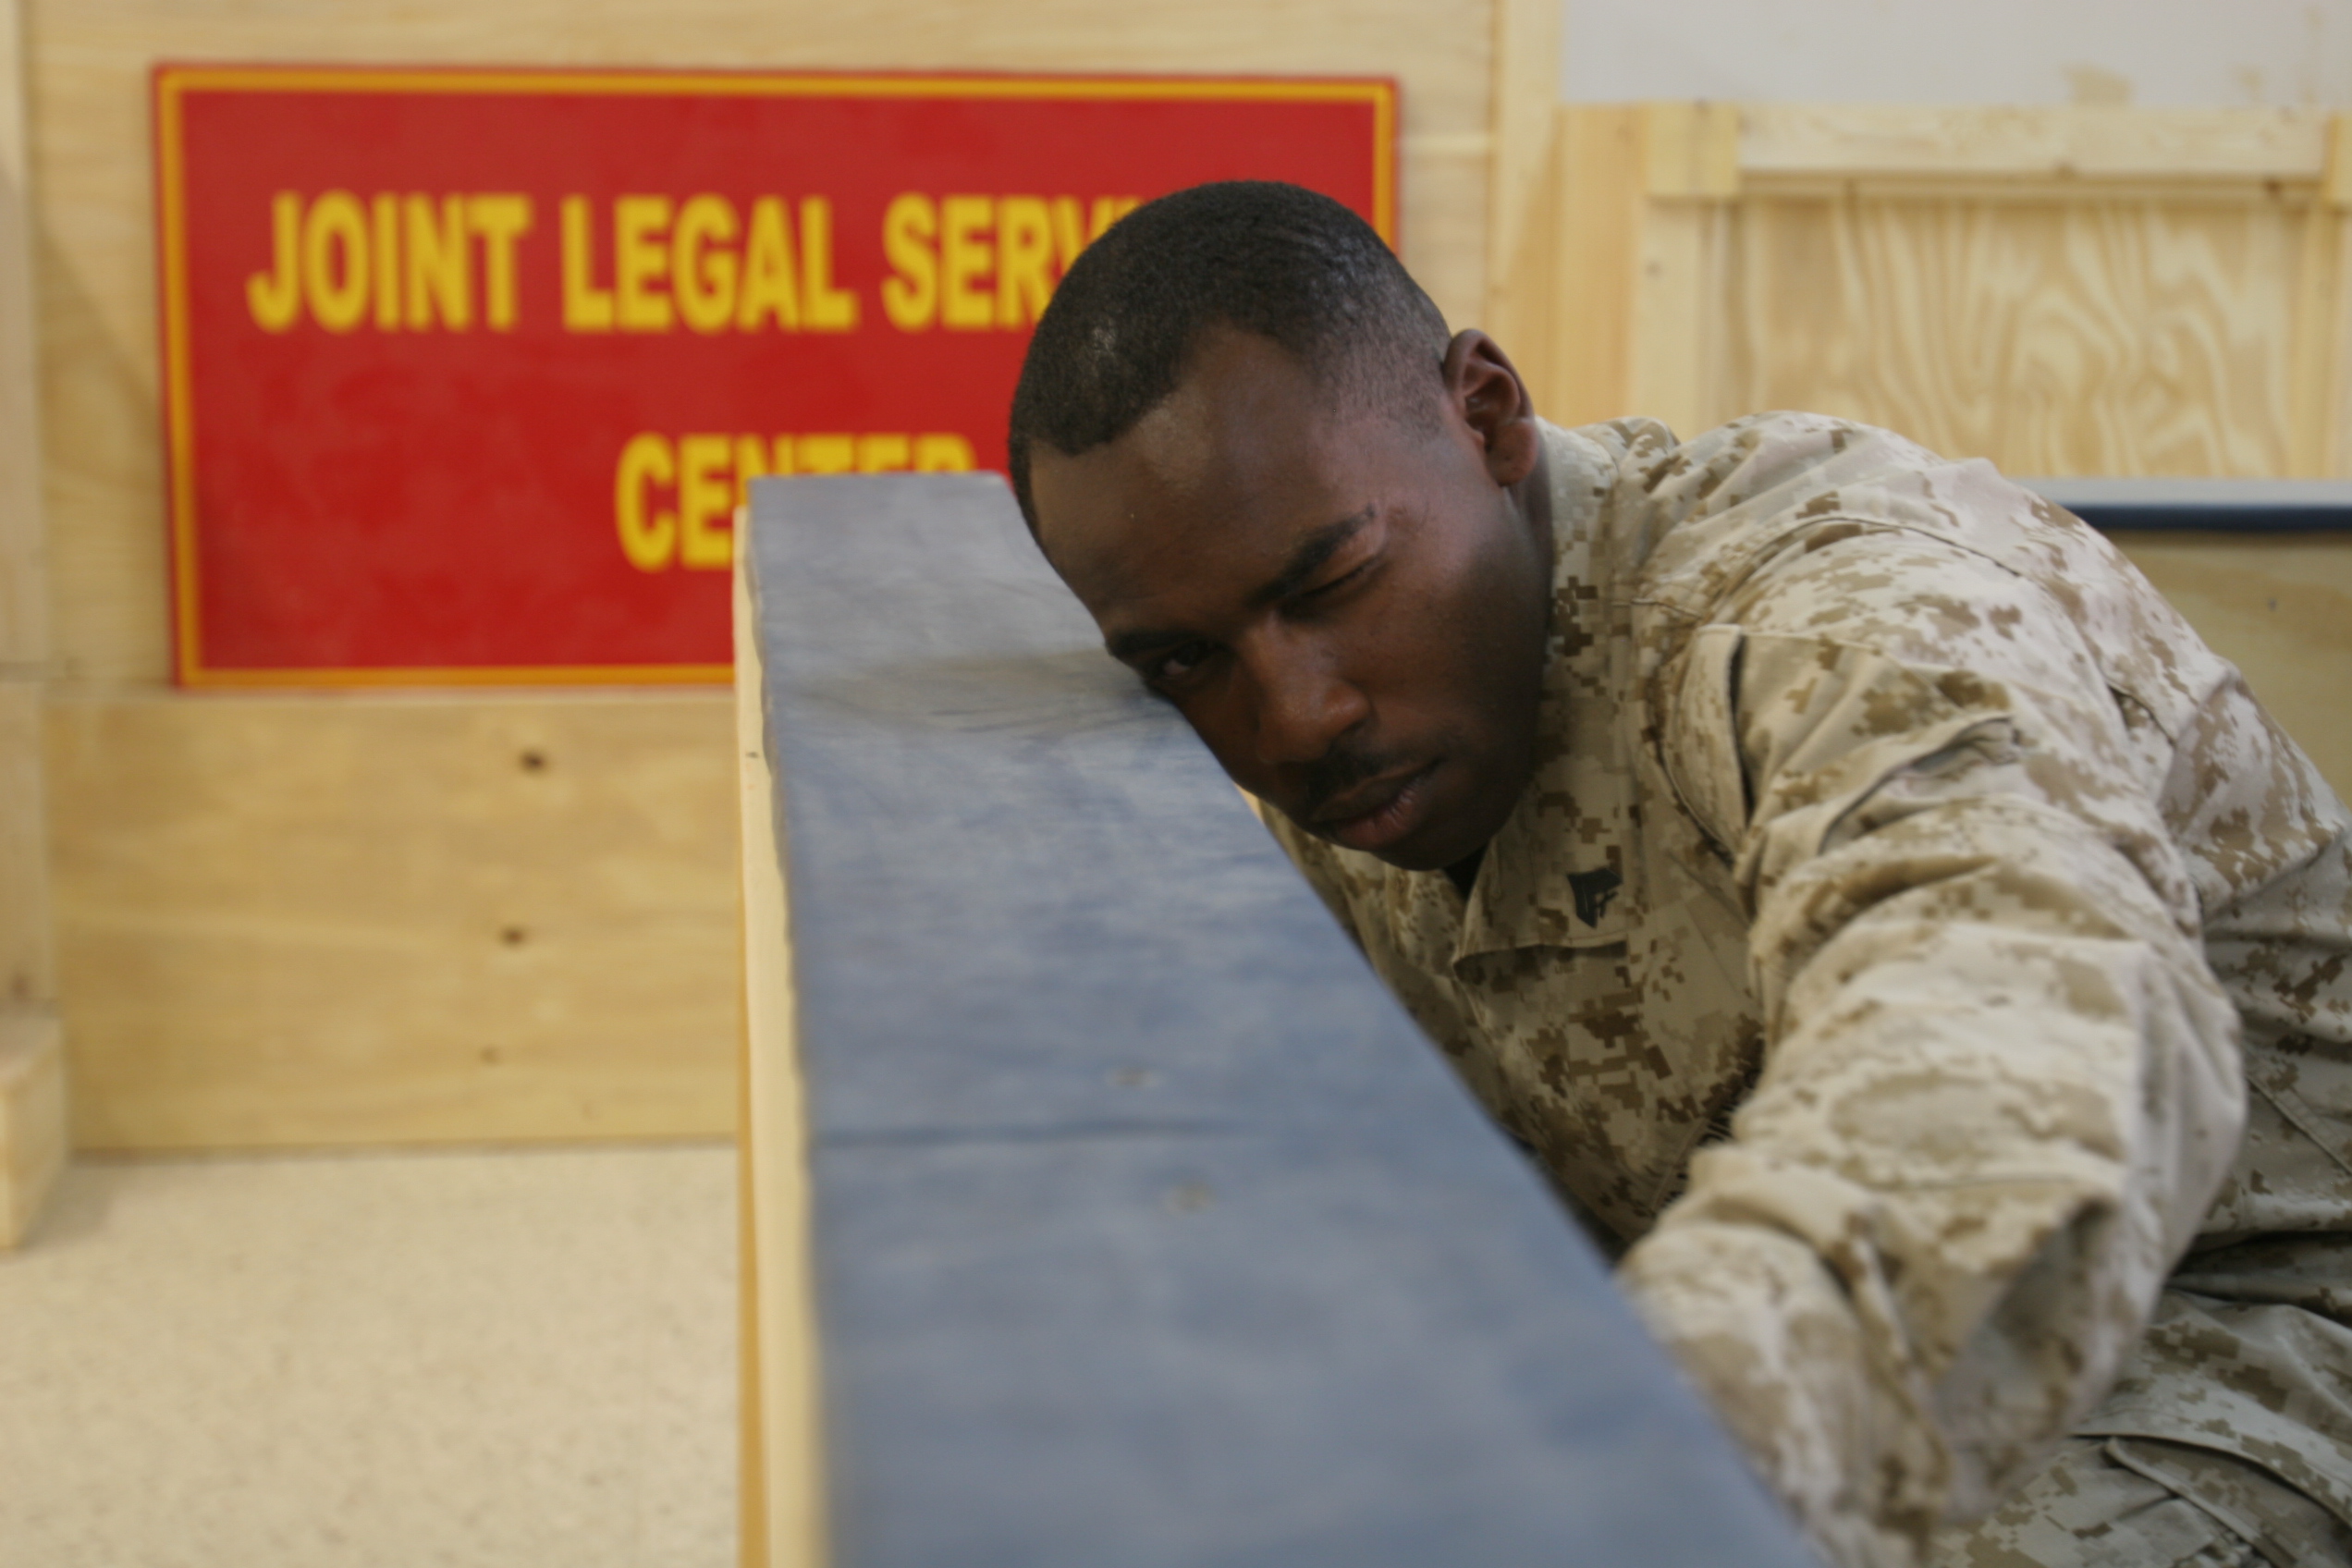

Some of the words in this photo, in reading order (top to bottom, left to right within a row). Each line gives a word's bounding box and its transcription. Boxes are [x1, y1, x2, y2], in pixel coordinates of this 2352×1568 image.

[247, 192, 533, 331] JOINT
[560, 194, 858, 333] LEGAL
[882, 191, 1145, 333] SERV
